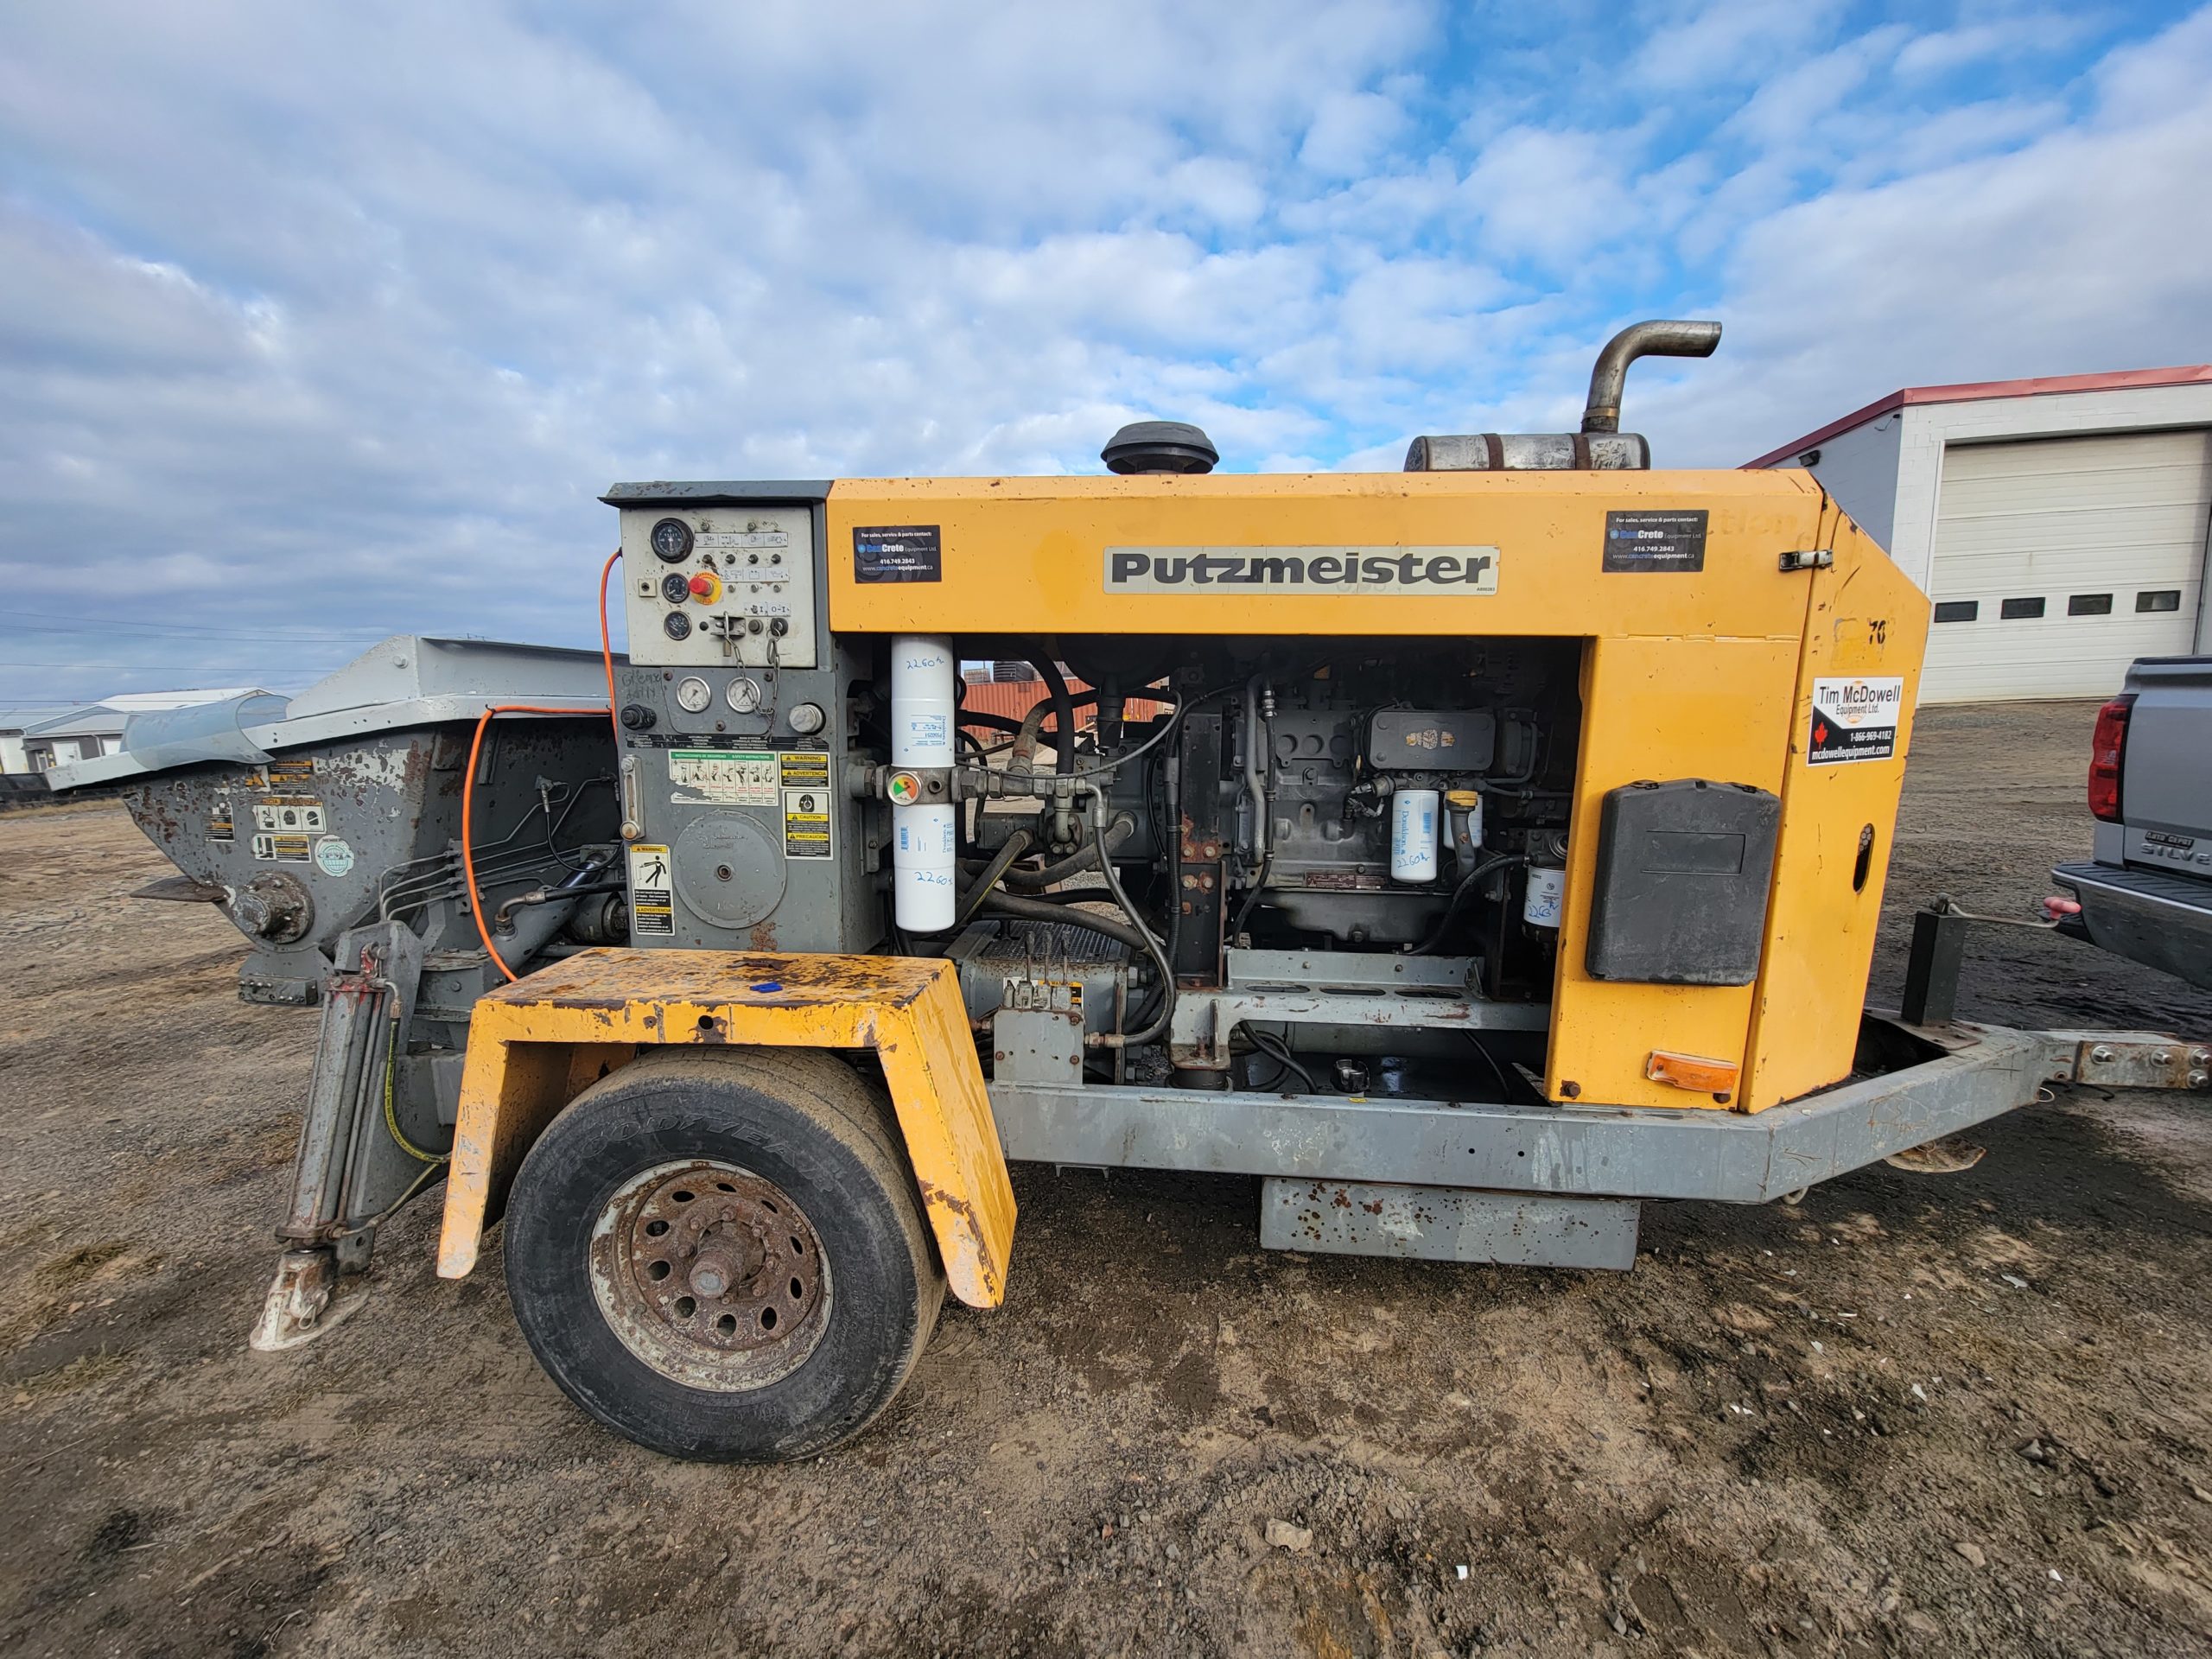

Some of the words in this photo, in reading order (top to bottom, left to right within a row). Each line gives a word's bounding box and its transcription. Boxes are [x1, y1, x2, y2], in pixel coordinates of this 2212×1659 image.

[1111, 551, 1491, 584] Putzmeister
[1819, 686, 1840, 704] Tim
[1842, 684, 1901, 703] McDowell
[1836, 704, 1867, 716] Equipment
[1868, 703, 1879, 714] Ltd.
[1850, 730, 1892, 742] 1-866-969-4182
[1811, 745, 1890, 760] mcdowellequipment.com
[2141, 842, 2211, 866] SILVE
